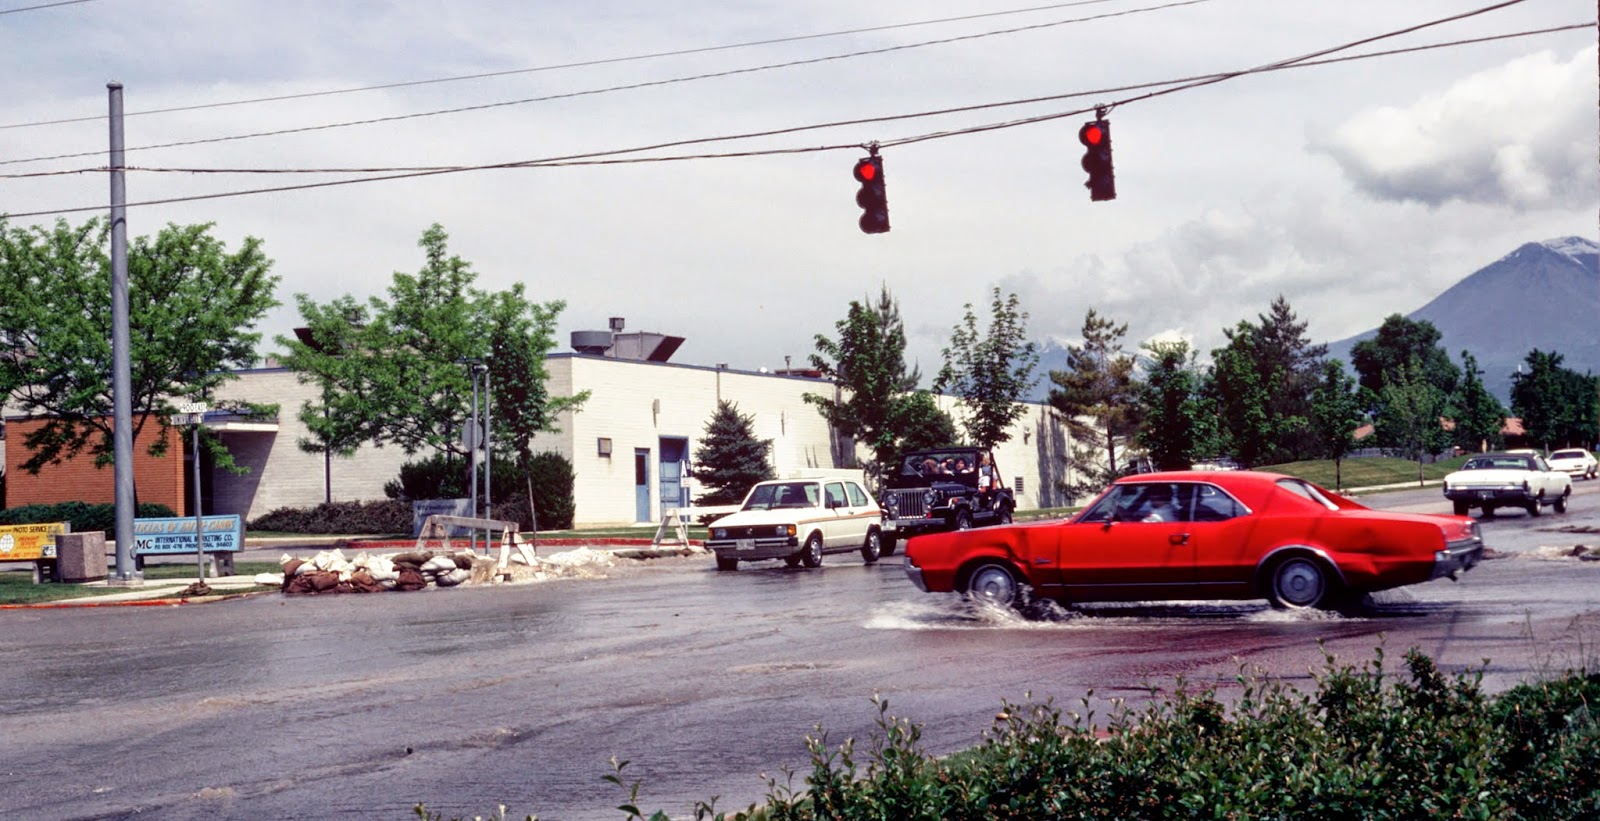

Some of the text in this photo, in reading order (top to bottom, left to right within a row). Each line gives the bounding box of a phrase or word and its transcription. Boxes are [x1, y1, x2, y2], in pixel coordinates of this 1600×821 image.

[155, 535, 192, 543] INTERNATIONAL
[194, 534, 222, 542] MRKETING
[136, 539, 153, 550] MC
